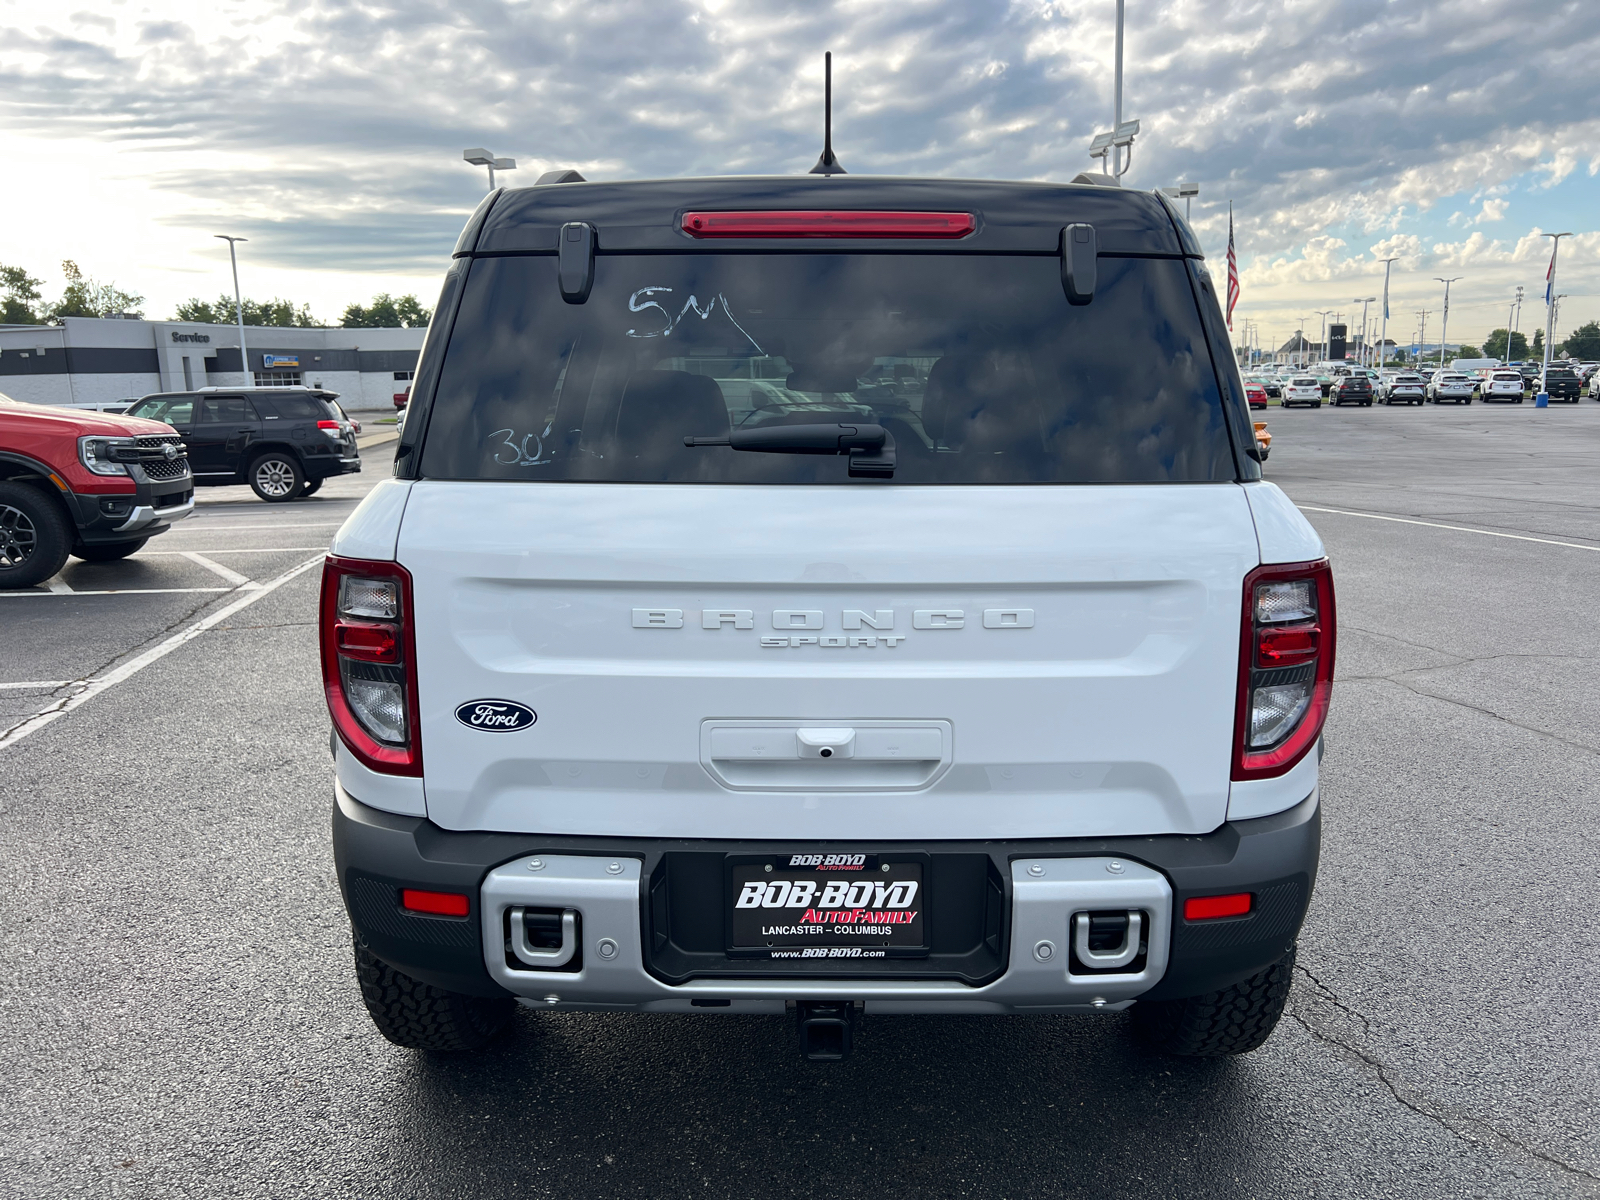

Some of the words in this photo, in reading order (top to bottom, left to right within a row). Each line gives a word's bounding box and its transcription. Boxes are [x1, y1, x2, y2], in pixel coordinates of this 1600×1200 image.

[172, 331, 210, 343] Service
[631, 608, 1036, 630] BRONCO
[760, 635, 906, 648] SPORT
[470, 704, 520, 726] Ford
[735, 881, 919, 909] BOB-BOYD
[762, 926, 823, 935] LANCASTER
[834, 926, 892, 935] COLUMBUS
